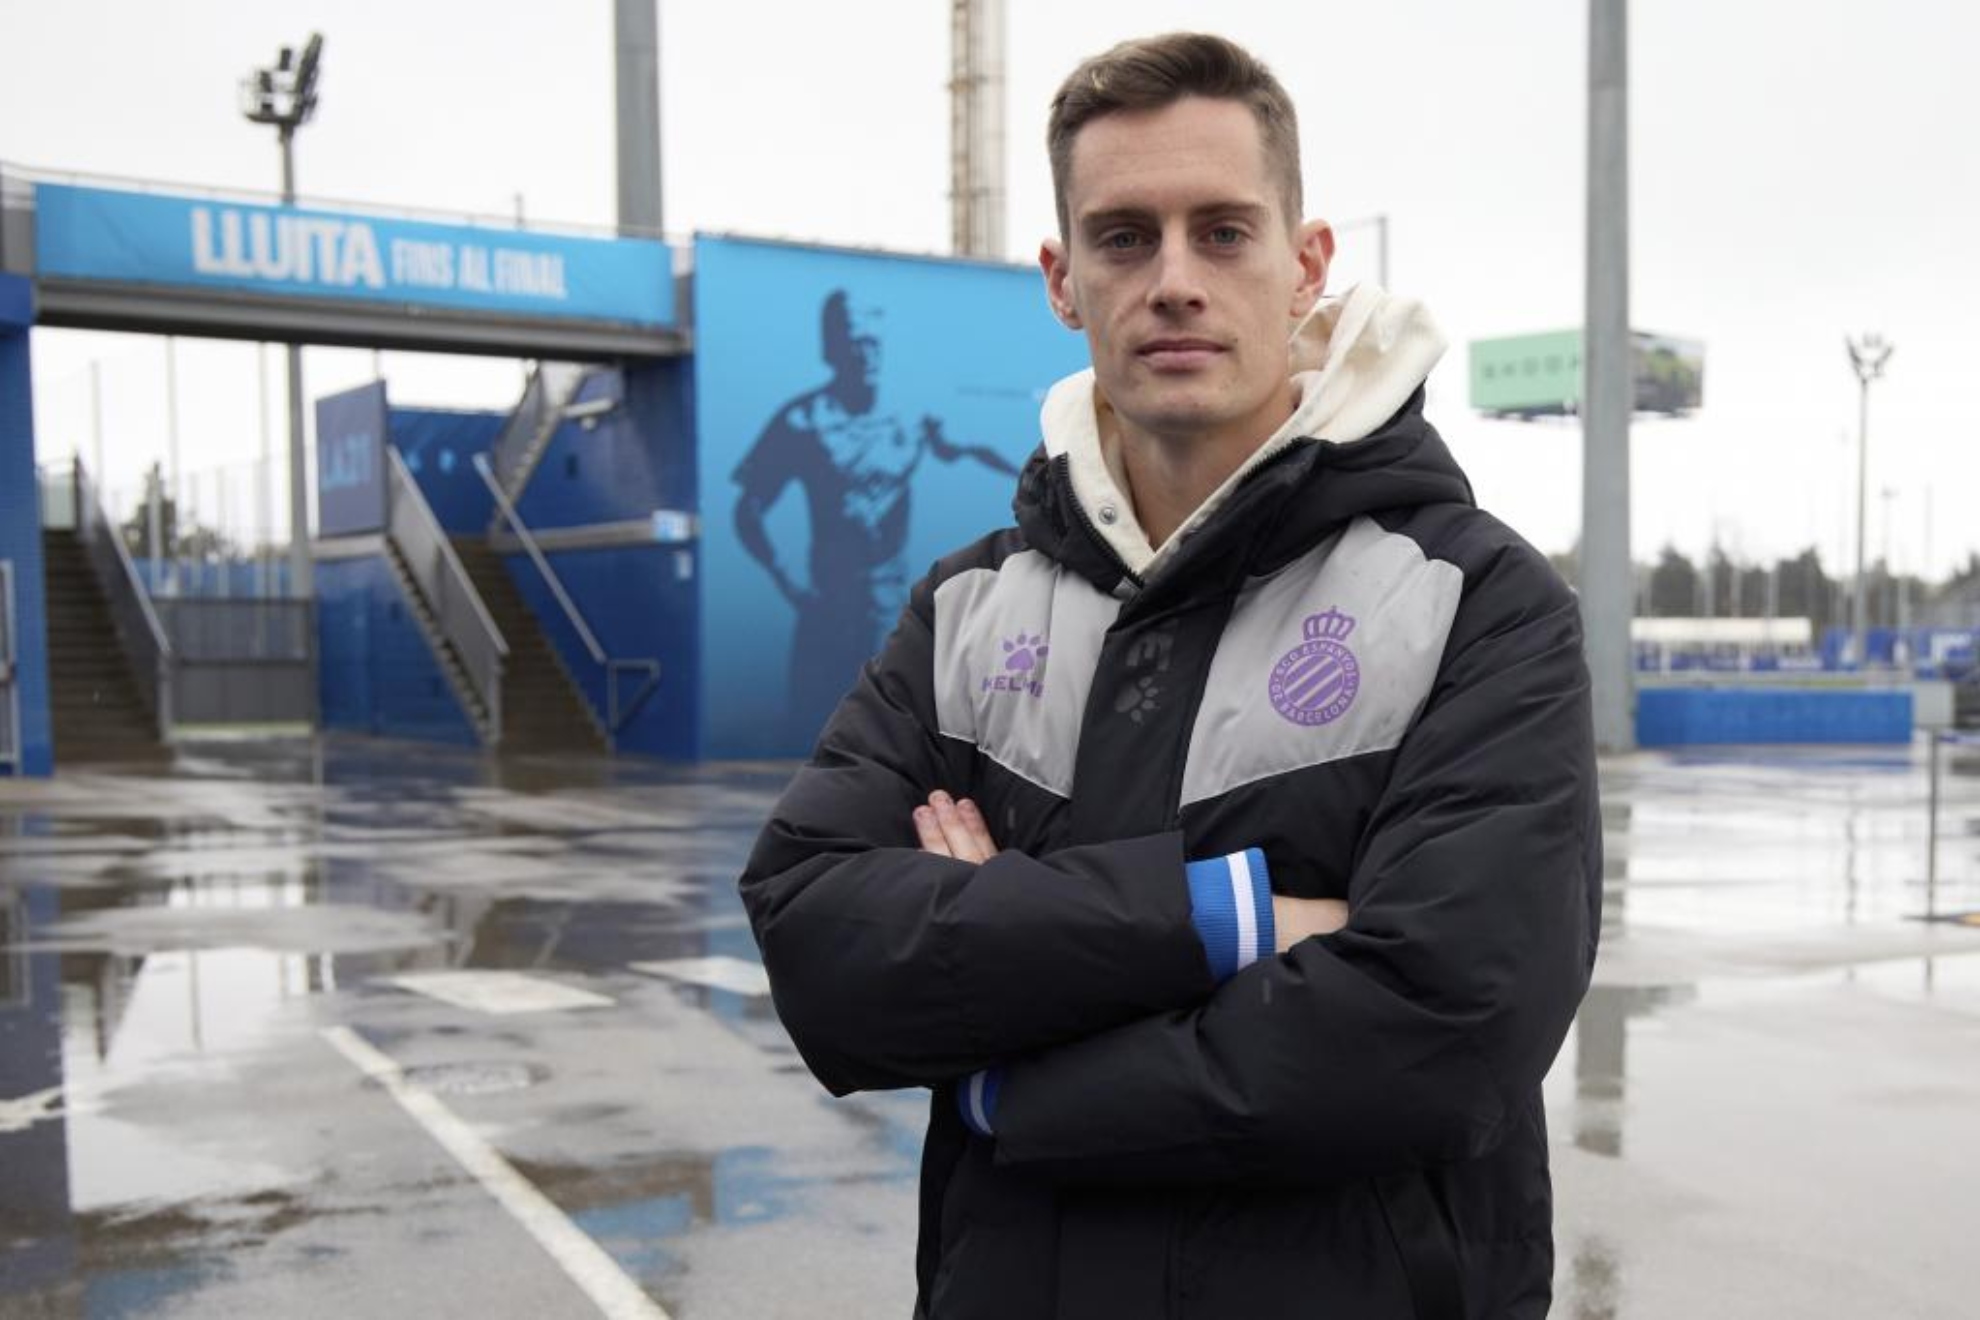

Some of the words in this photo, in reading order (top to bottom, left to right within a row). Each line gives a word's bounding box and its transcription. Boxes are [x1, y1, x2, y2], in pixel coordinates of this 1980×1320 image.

[191, 208, 386, 290] LLUITA
[391, 238, 454, 287] FINS
[457, 246, 493, 293] AL
[494, 249, 567, 299] FINAL
